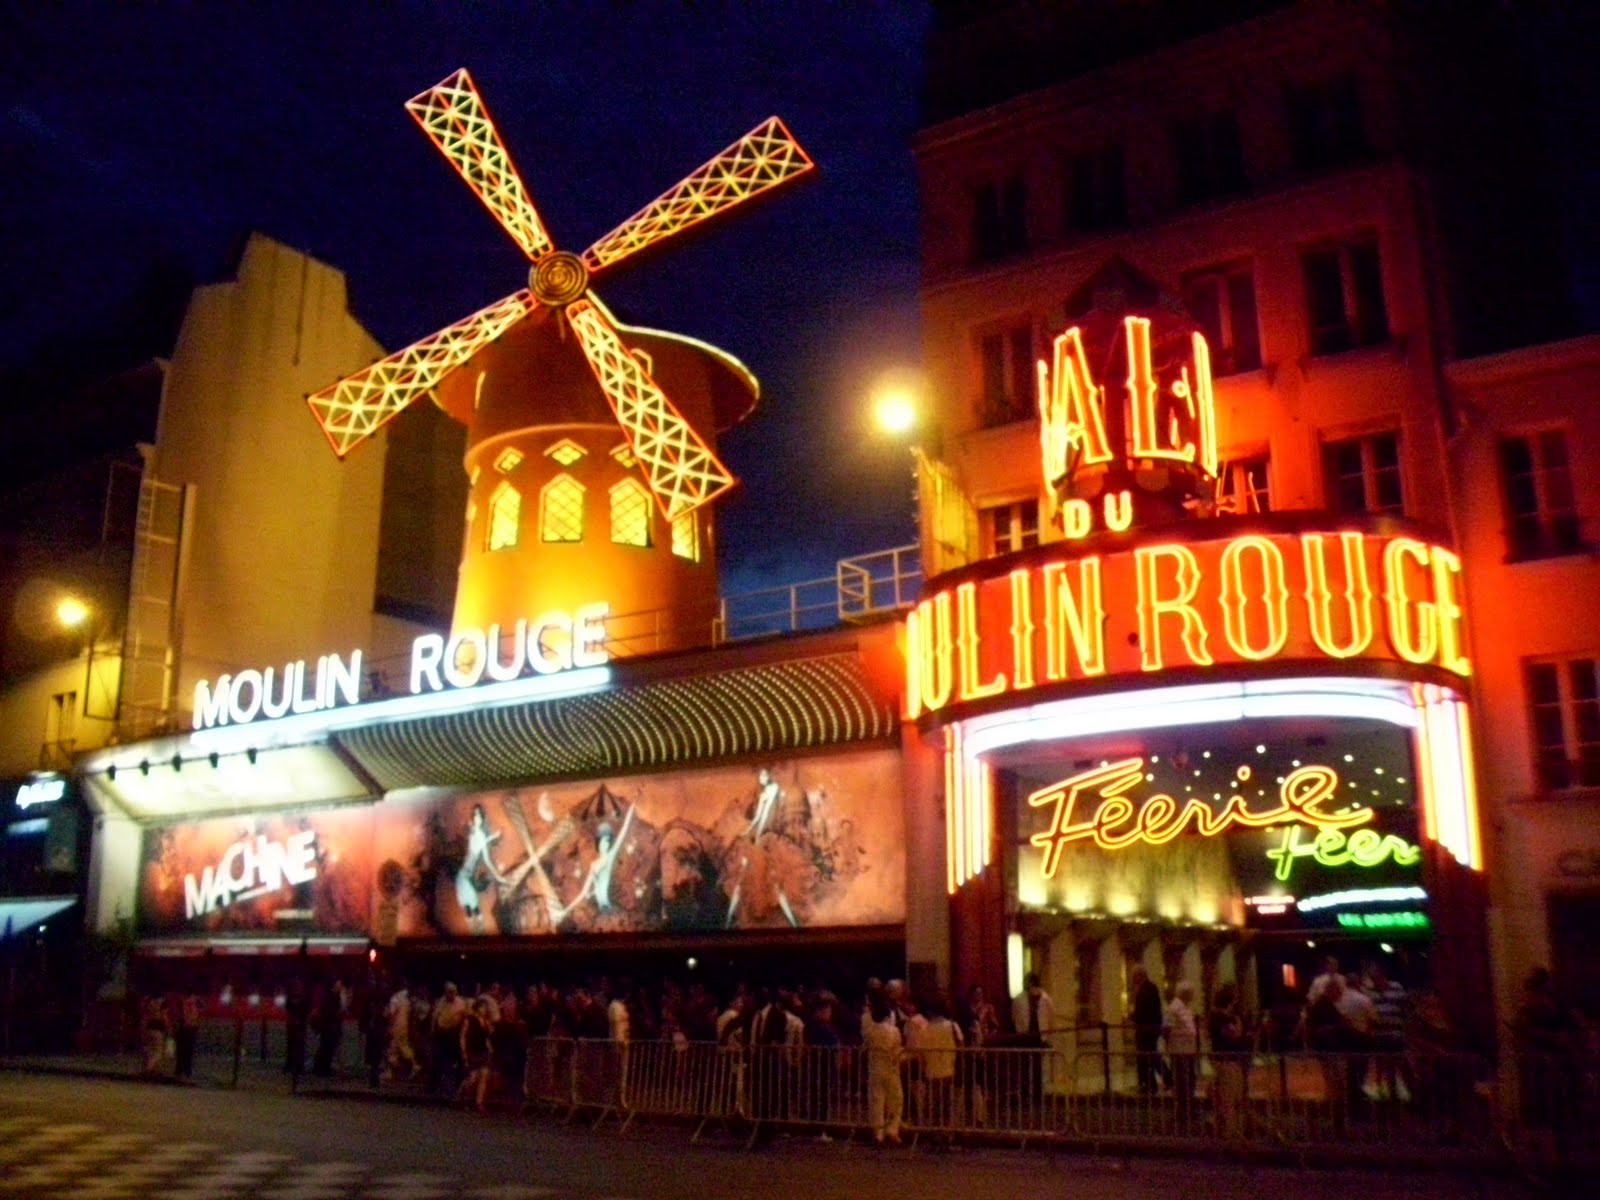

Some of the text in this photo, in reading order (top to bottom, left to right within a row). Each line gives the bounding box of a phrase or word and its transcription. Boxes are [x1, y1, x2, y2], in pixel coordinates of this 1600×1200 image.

[1062, 490, 1133, 539] DU
[1134, 531, 1471, 677] ROUGE
[192, 601, 610, 729] MOULIN ROUGE
[184, 831, 318, 919] MACHINE
